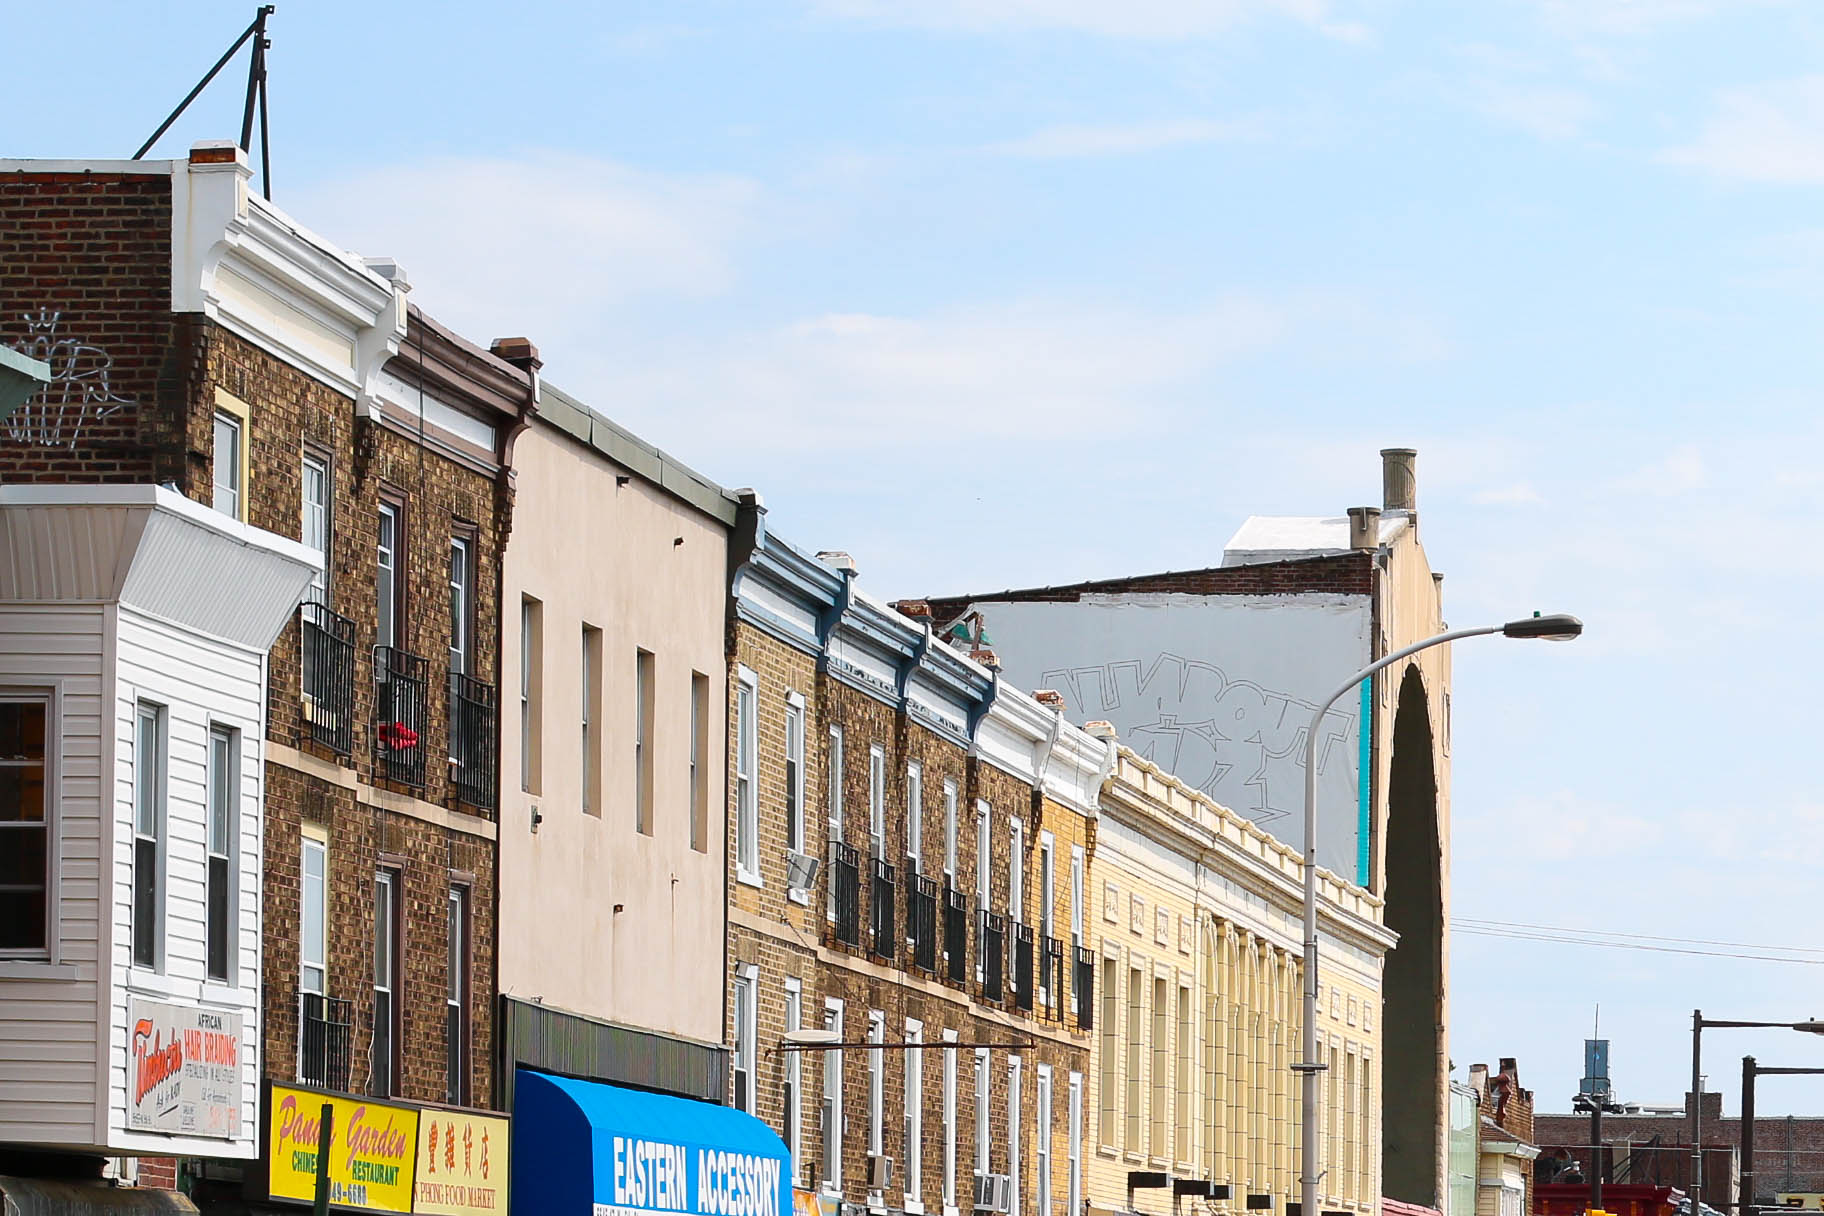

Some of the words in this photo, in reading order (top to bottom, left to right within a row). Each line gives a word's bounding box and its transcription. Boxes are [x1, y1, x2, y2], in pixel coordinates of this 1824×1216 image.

[198, 1013, 222, 1030] AFRICAN
[184, 1028, 202, 1061] HAIR
[205, 1032, 236, 1067] BRAIDING
[346, 1106, 406, 1171] Garden
[292, 1151, 320, 1174] CHINES
[352, 1159, 400, 1187] RESTAURANT
[613, 1136, 688, 1211] EASTERN
[420, 1182, 444, 1203] PHONG
[446, 1185, 465, 1206] FOOD
[467, 1186, 496, 1210] MARKET
